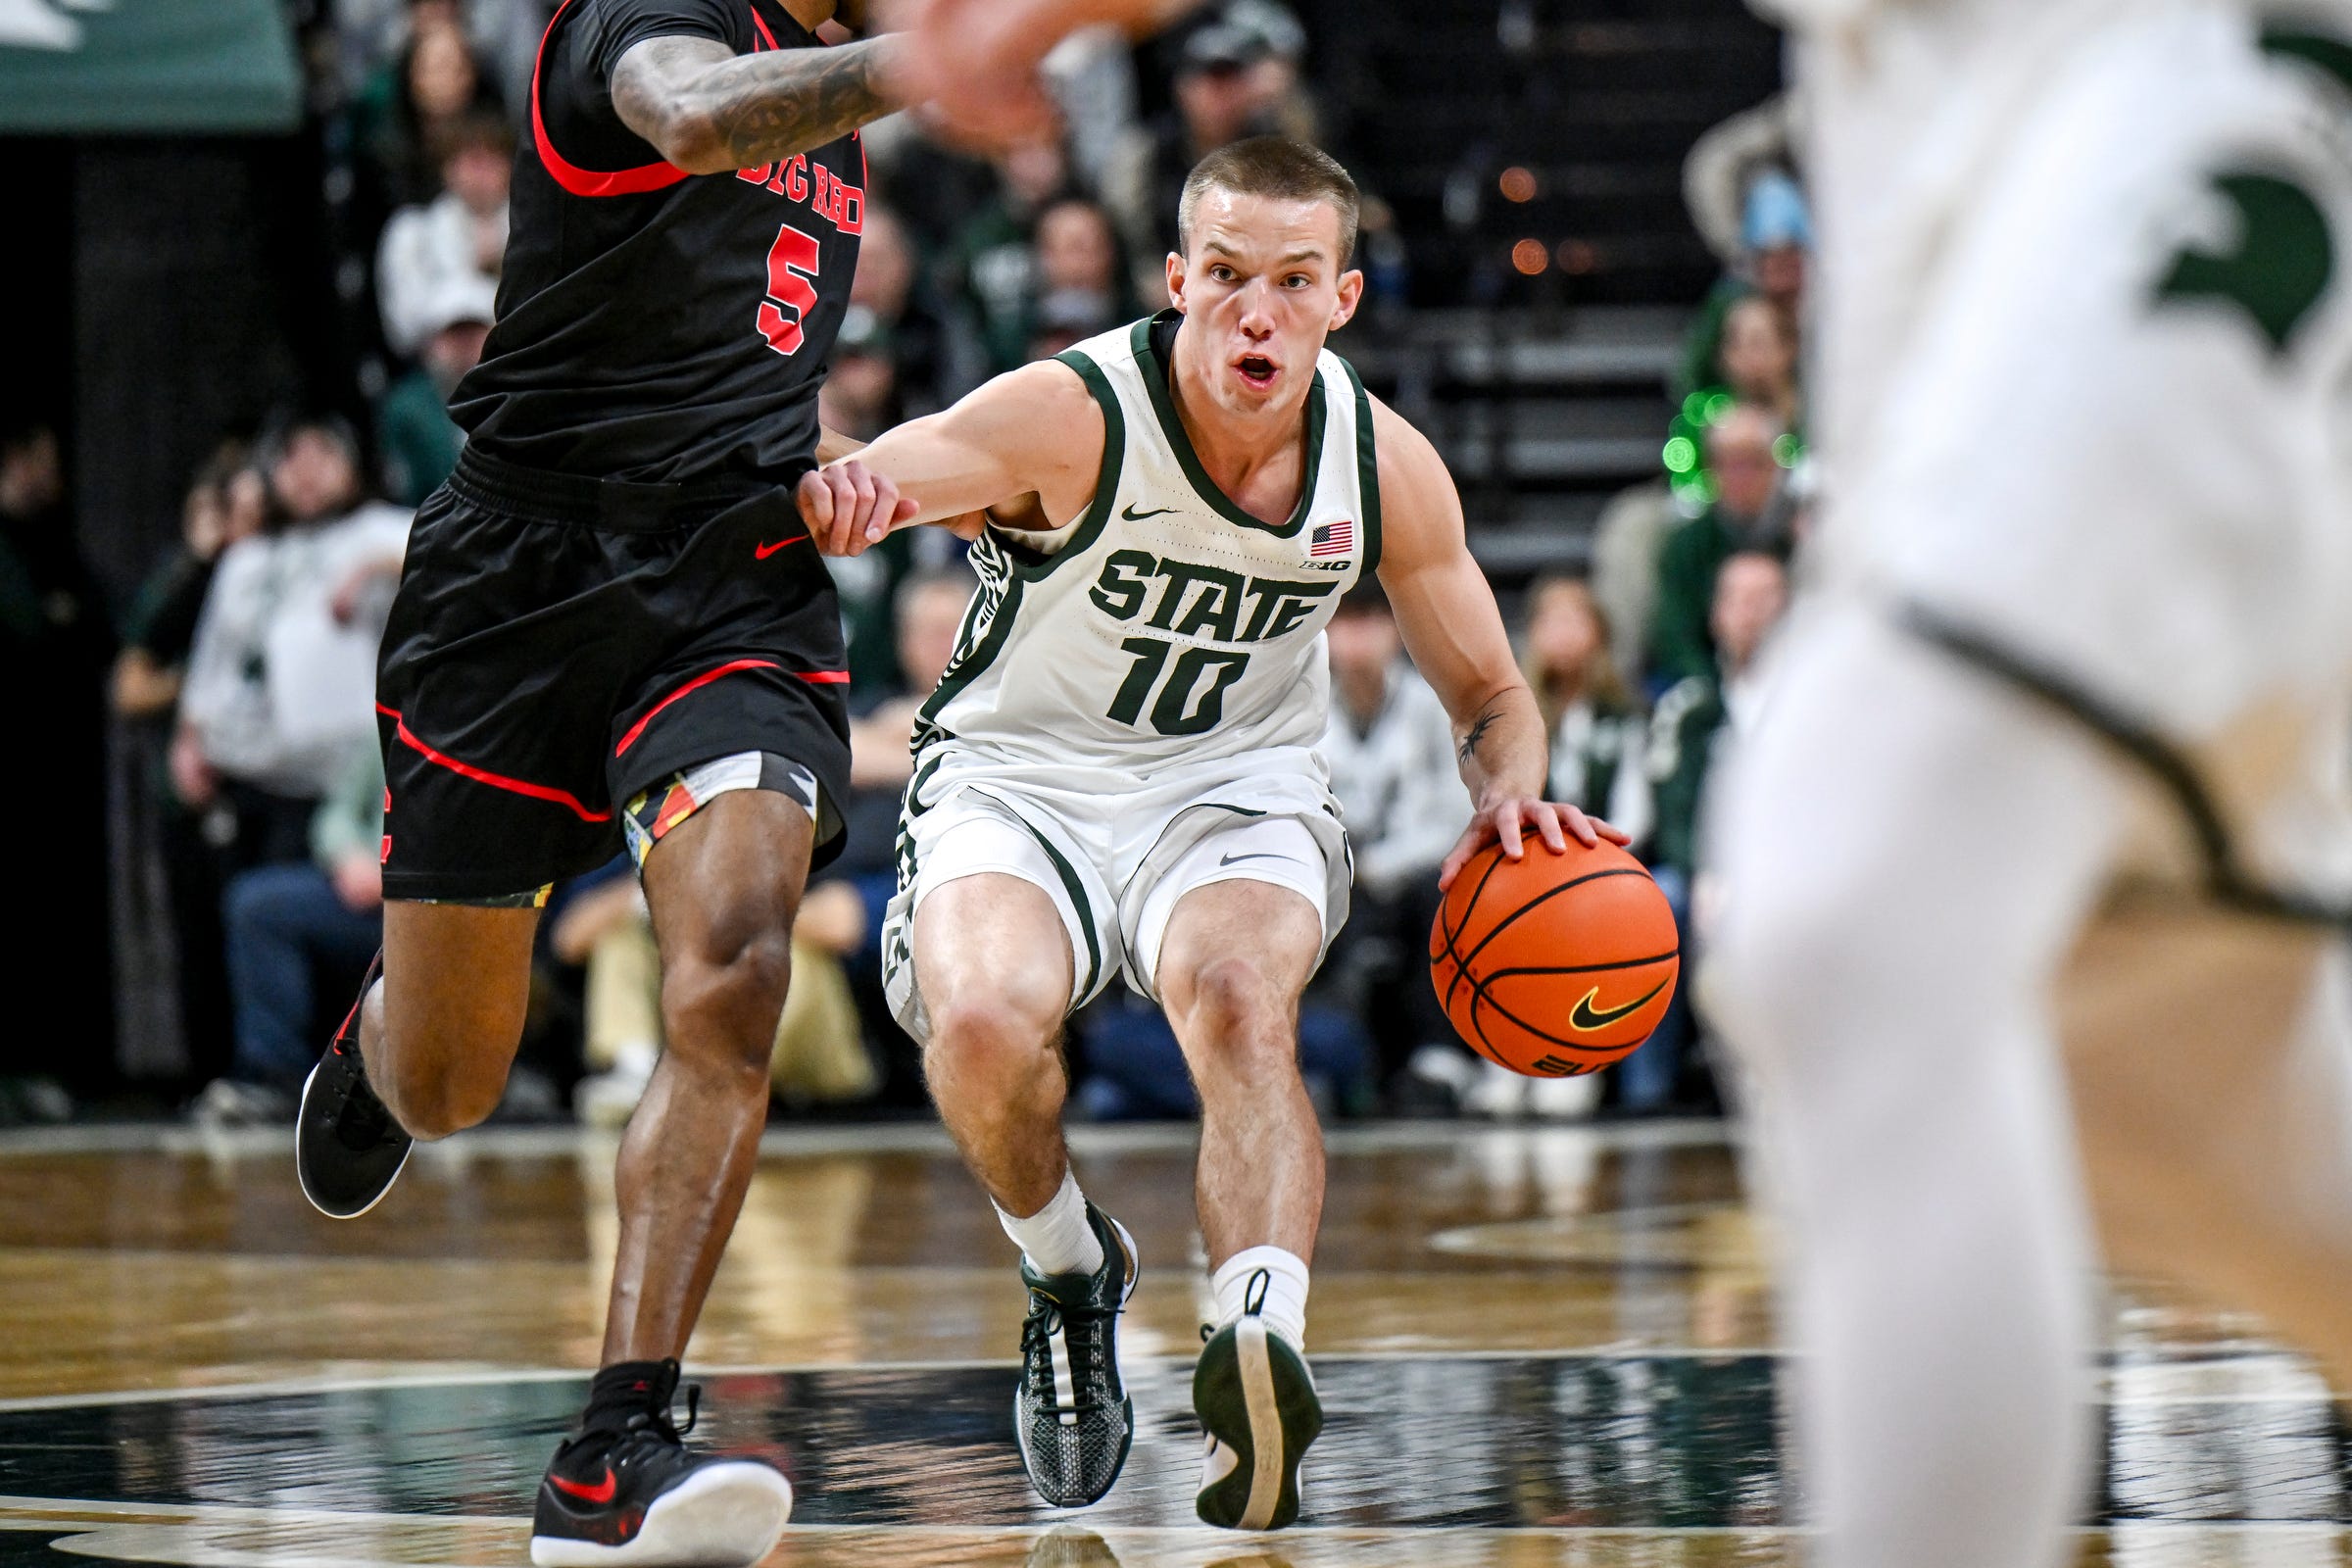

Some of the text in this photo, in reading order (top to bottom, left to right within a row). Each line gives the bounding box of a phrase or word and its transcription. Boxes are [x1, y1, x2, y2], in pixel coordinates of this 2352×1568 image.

[811, 162, 865, 236] RED
[756, 223, 820, 356] 5
[1088, 549, 1341, 643] STATE
[1105, 637, 1251, 736] 10
